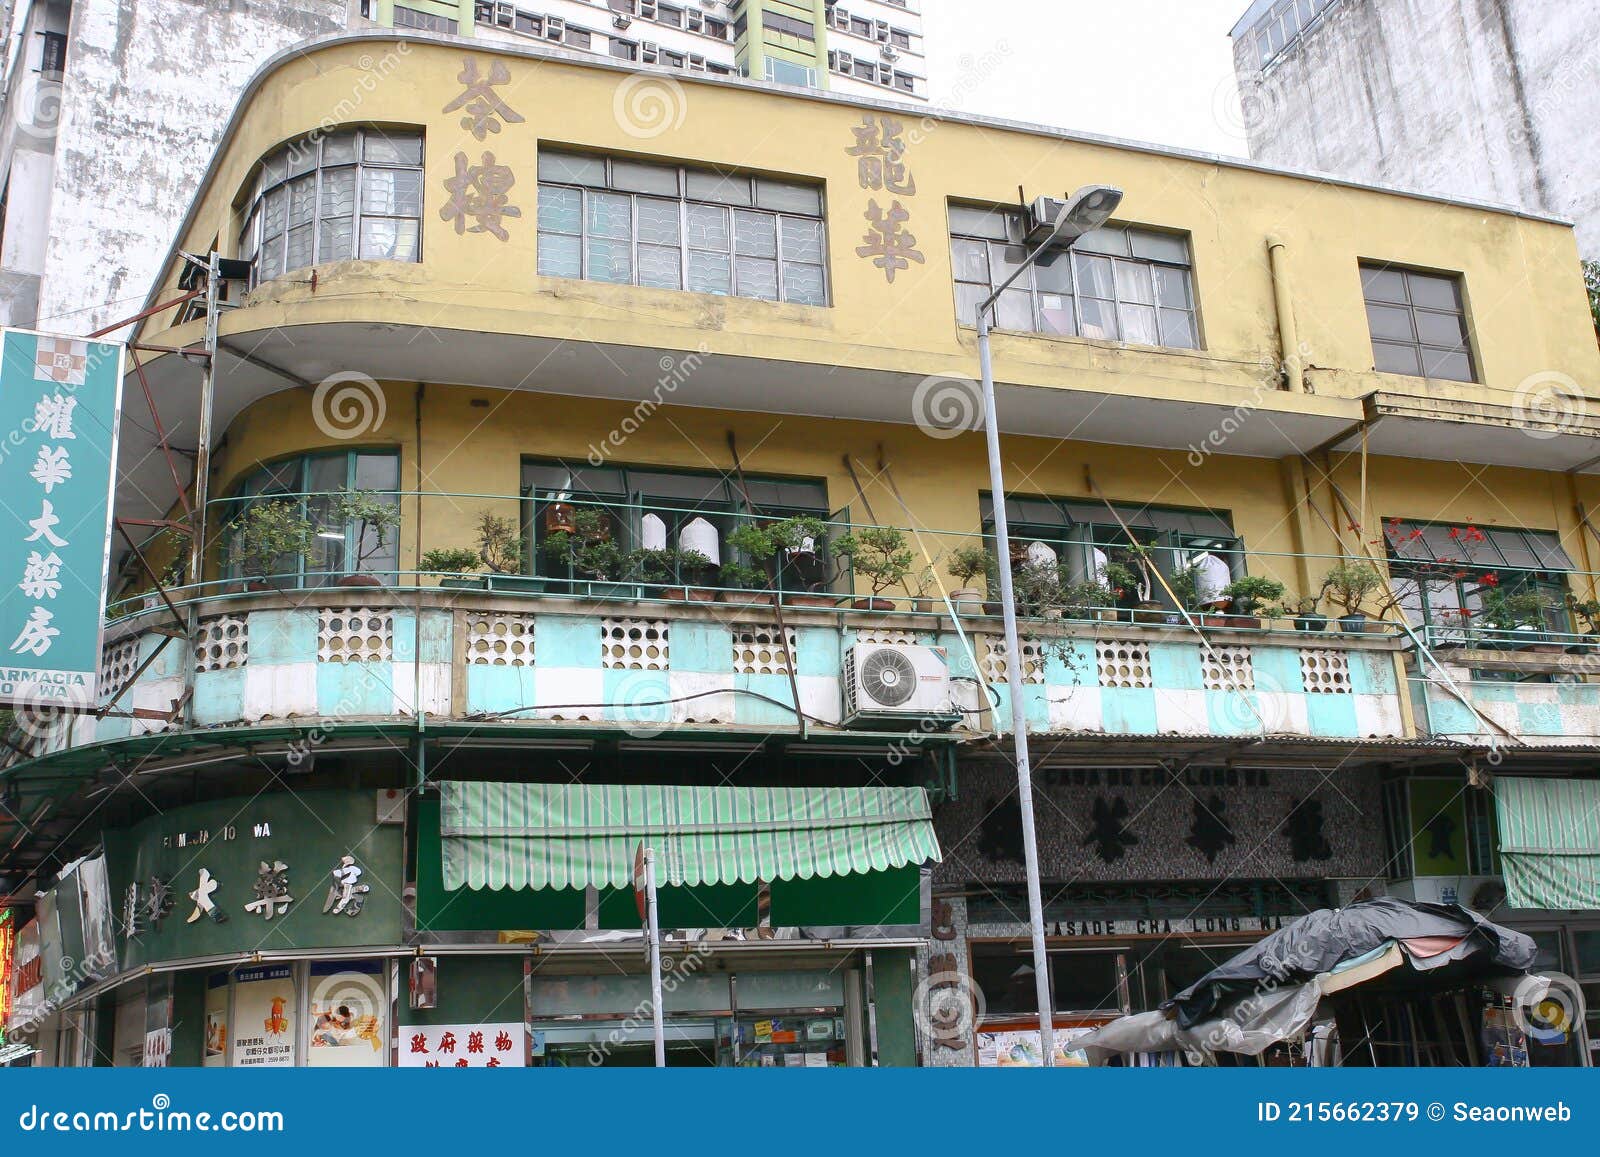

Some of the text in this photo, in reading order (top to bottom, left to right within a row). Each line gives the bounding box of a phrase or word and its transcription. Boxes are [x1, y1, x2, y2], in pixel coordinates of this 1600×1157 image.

[439, 55, 526, 242] 茶樓
[844, 112, 926, 284] 龍華
[253, 822, 271, 838] WA
[1136, 918, 1172, 934] CHA
[1192, 917, 1240, 932] LONG
[410, 1030, 513, 1054] 政府藥物
